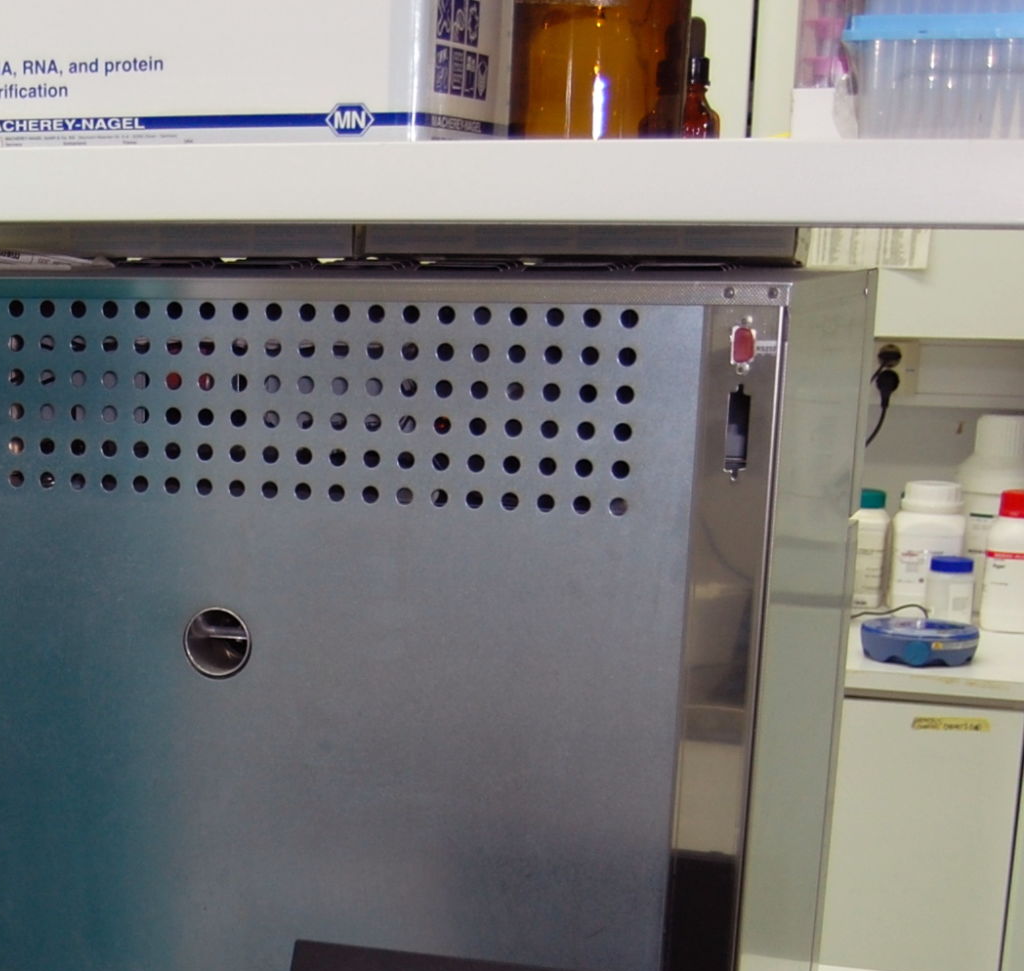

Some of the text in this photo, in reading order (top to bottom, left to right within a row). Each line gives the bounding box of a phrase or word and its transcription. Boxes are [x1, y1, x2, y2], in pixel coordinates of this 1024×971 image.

[22, 60, 63, 76] RNA,
[68, 58, 99, 74] and
[104, 56, 164, 76] protein
[333, 110, 366, 130] MN
